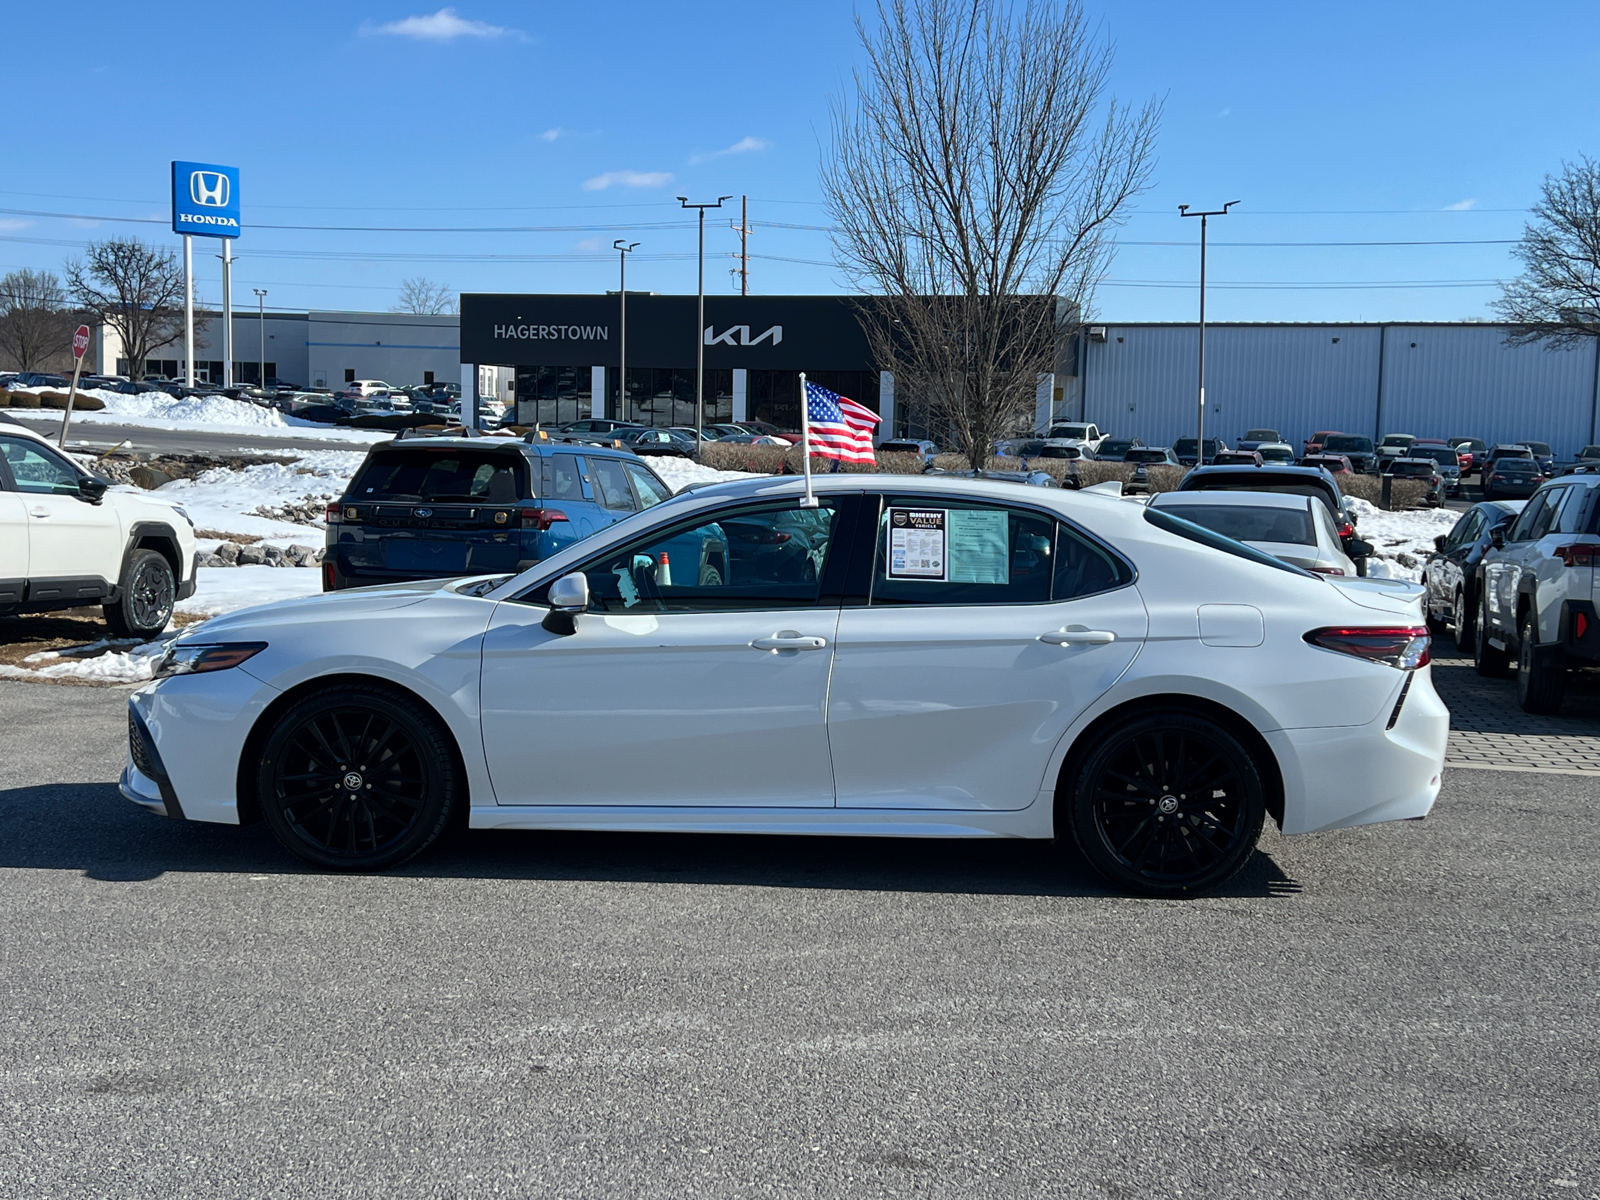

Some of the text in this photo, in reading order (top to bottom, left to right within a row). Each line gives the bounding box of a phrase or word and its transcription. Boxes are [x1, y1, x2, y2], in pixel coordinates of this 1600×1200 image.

[179, 213, 239, 227] HONDA
[493, 324, 609, 341] HAGERSTOWN
[703, 325, 783, 346] KIA
[74, 334, 89, 349] STOP
[378, 518, 467, 528] OUTBACK
[909, 517, 943, 525] VALUE
